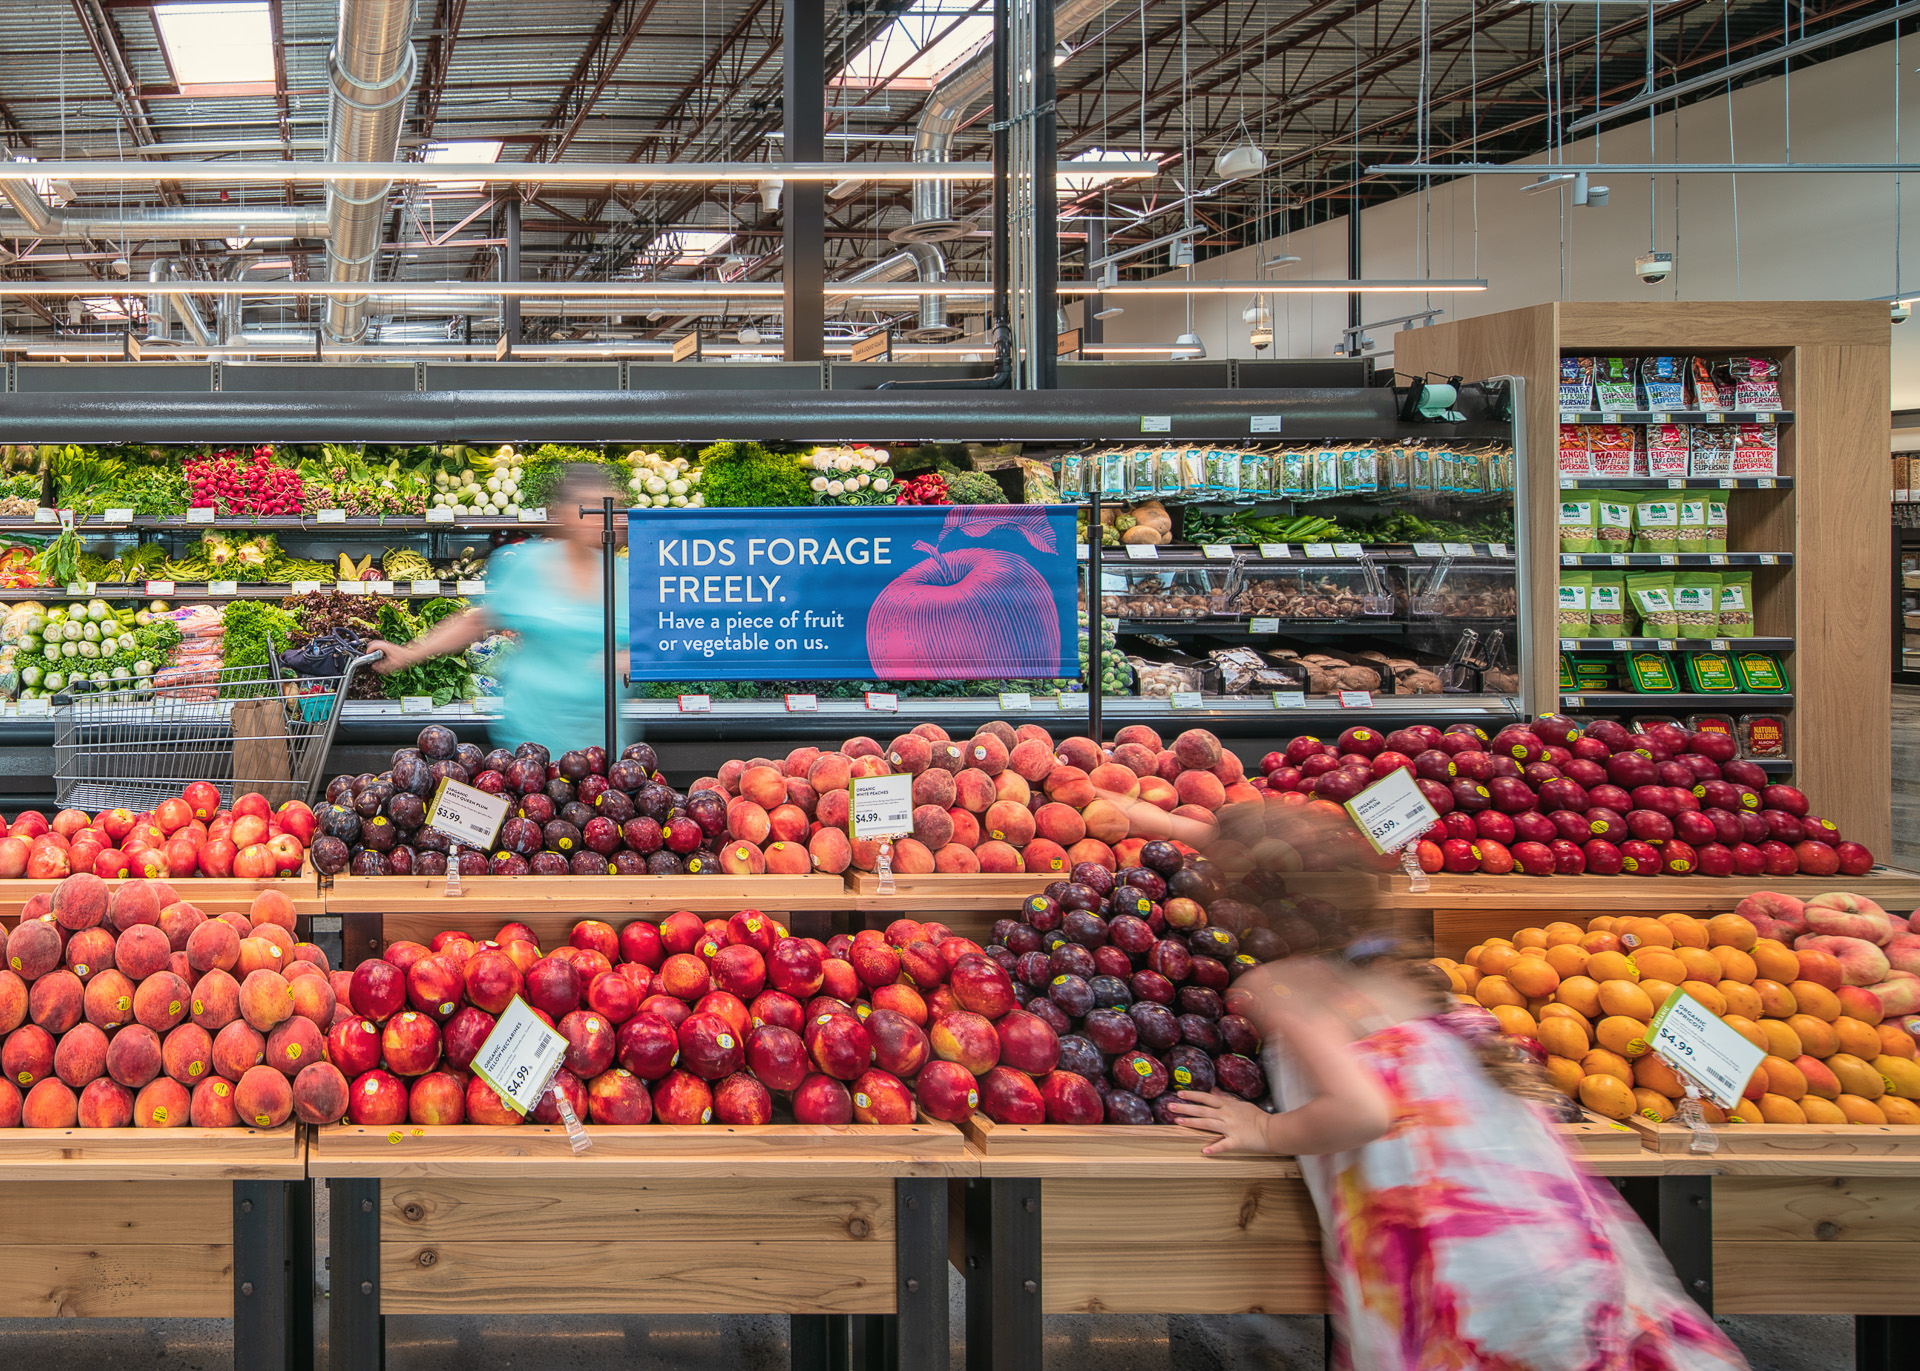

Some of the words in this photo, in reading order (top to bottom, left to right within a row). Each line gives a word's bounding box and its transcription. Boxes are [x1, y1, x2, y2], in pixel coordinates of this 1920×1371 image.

[1738, 396, 1781, 405] SUPERSNAC
[1560, 451, 1588, 459] ANGOE
[1595, 451, 1630, 460] MANGOE
[1694, 452, 1717, 460] FIGY
[659, 538, 736, 567] KIDS
[748, 537, 892, 566] FORAGE
[659, 575, 787, 603] FREELY.
[659, 611, 705, 629] Have
[710, 617, 720, 629] a
[726, 610, 774, 636] piece
[779, 610, 800, 628] of
[803, 610, 844, 628] fruit
[659, 638, 678, 651] or
[682, 633, 769, 657] vegetable
[774, 638, 797, 651] on
[804, 638, 829, 651] us.
[1753, 726, 1779, 734] NATURAL
[445, 790, 460, 799] EARLY
[459, 795, 476, 805] QUEEN
[475, 802, 489, 811] PLUM
[447, 786, 469, 798] ORGANIC
[1356, 796, 1378, 812] ORGANIC
[1359, 807, 1370, 816] RED
[1368, 800, 1381, 811] PLUM
[436, 807, 460, 823] $3.99
[855, 812, 878, 824] $4.99
[1371, 819, 1396, 839] $3.99
[1674, 1008, 1705, 1033] APRICOTS
[1677, 1003, 1708, 1028] ORGANIC
[487, 1051, 503, 1073] YELLOW
[500, 1021, 523, 1054] NECTARINES
[1659, 1027, 1695, 1057] $4.99
[483, 1043, 502, 1070] ORGANIC
[506, 1064, 531, 1097] $4.99
